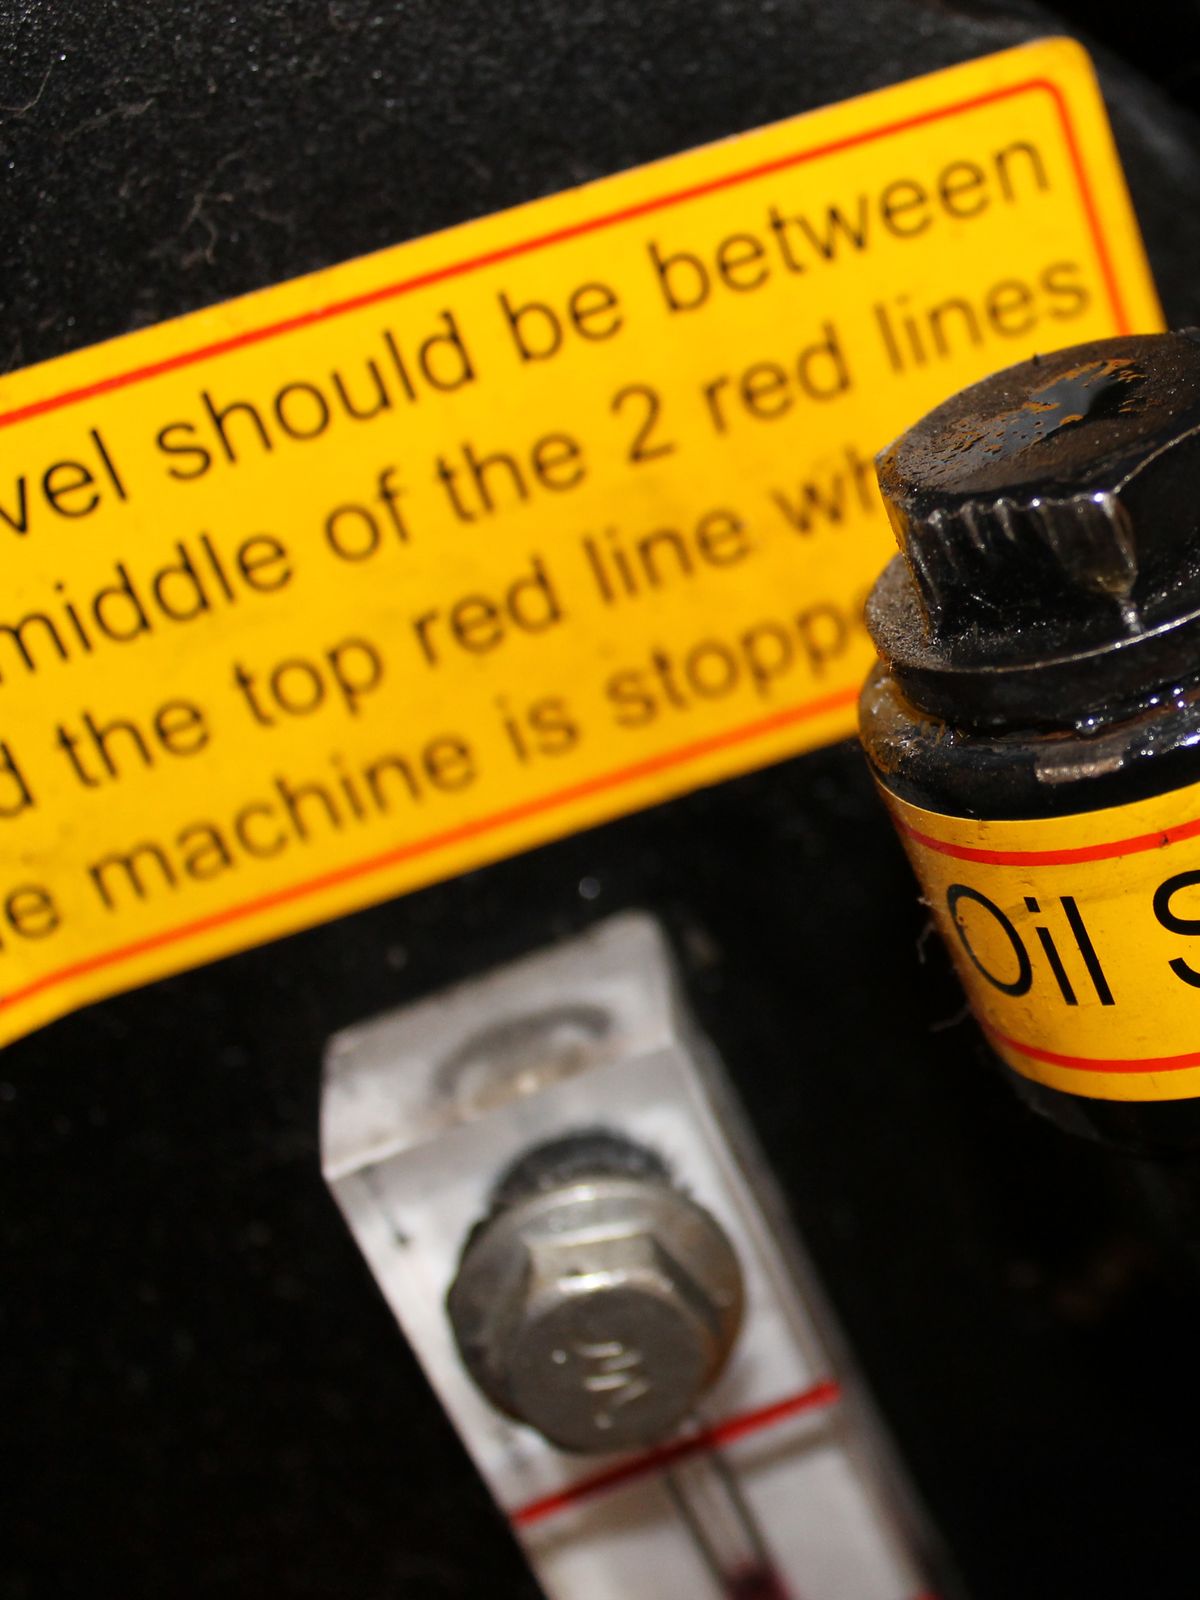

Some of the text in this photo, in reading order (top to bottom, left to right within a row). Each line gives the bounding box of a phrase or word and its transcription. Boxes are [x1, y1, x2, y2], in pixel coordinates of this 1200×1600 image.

[0, 257, 1093, 686] middle of the 2 red lines
[155, 310, 476, 481] should
[497, 281, 625, 364] be
[647, 138, 1051, 315] between
[0, 585, 866, 955] e machine is stopp
[55, 698, 210, 789] the
[232, 636, 385, 728] top
[412, 553, 564, 668] red
[581, 506, 753, 605] line
[947, 884, 1115, 1006] Oil
